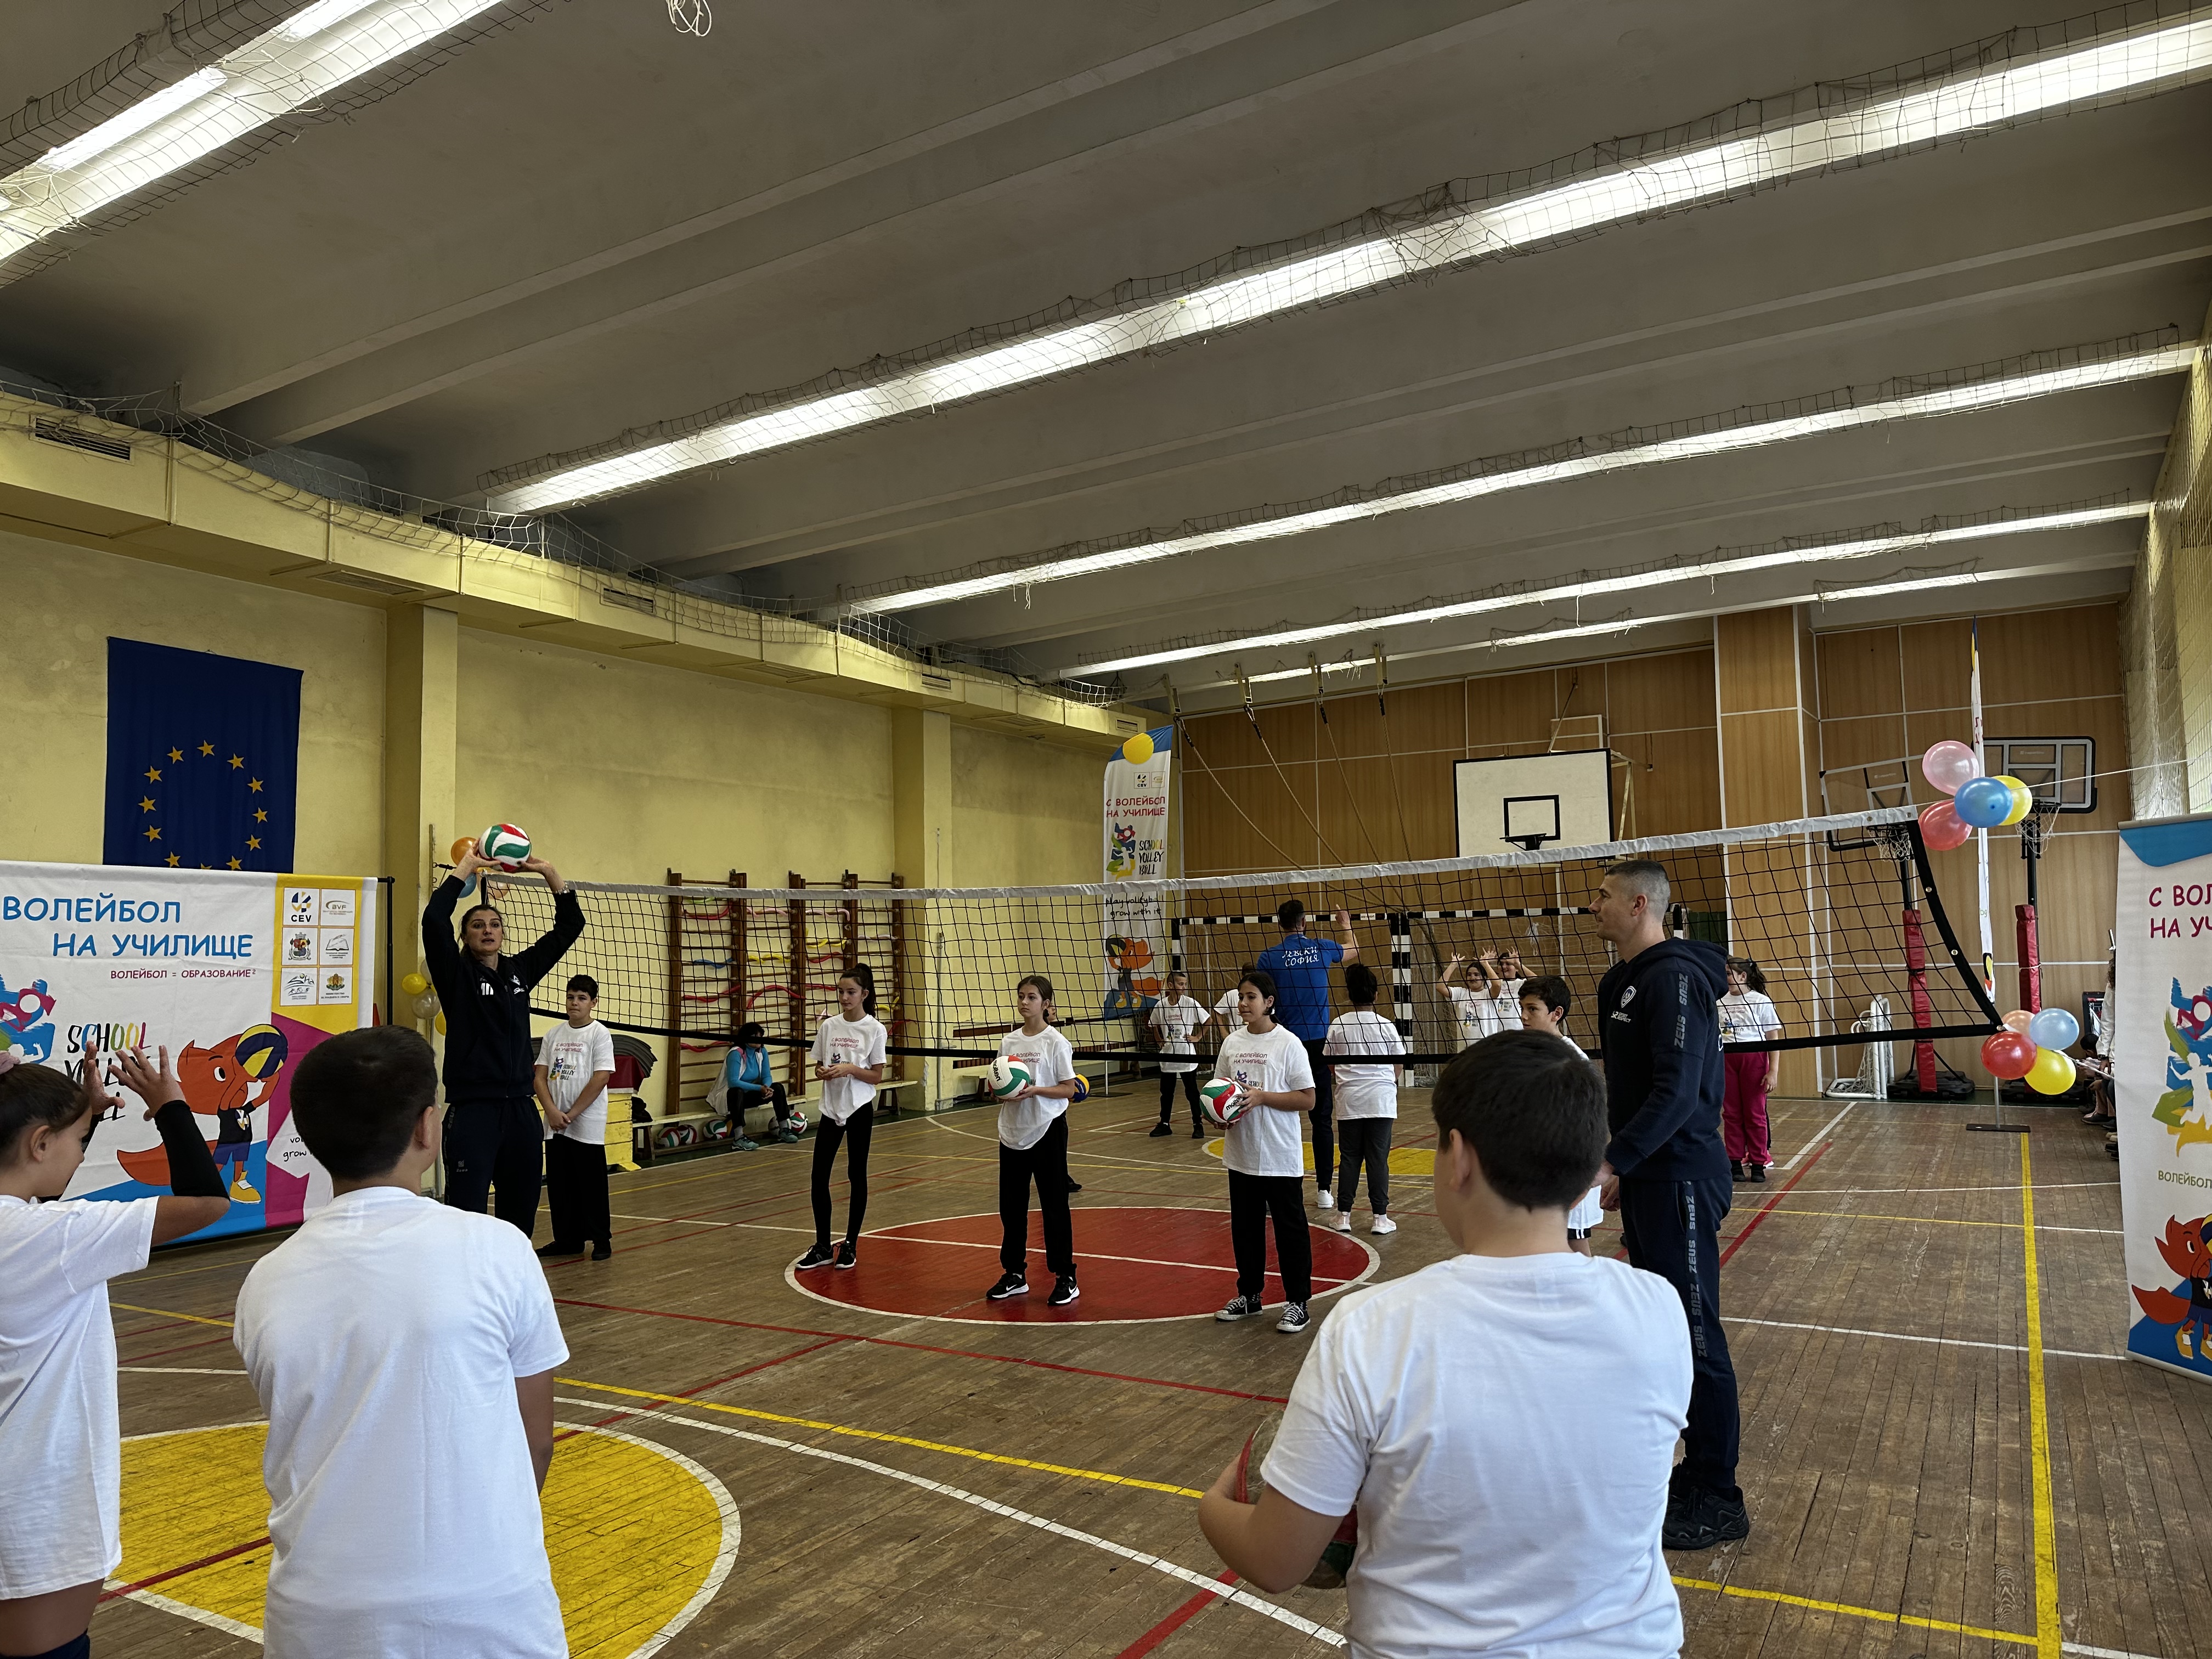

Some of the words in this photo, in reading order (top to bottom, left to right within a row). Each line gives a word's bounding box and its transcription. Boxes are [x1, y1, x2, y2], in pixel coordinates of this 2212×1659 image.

[1115, 795, 1165, 806] ВОЛЕЙБОЛ
[1106, 809, 1119, 817] НА
[1122, 807, 1165, 817] УЧИЛИЩЕ
[1139, 839, 1164, 851] SCHOOL
[1138, 851, 1164, 864] VOLLEY
[1139, 864, 1157, 876] BALL
[2149, 887, 2162, 907] С
[3, 892, 180, 923] ВОЛЕЙБОЛ
[1110, 910, 1130, 919] grow
[1133, 906, 1151, 916] with
[2151, 917, 2181, 939] НА
[53, 933, 97, 957] НА
[112, 934, 253, 960] УЧИЛИЩЕ
[1282, 946, 1318, 958] ЛЕВСКИ
[1285, 954, 1320, 967] СОФИЯ
[110, 968, 167, 979] ВОЛЕЙБОЛ
[1679, 973, 1689, 1006] ZEUS
[67, 1022, 152, 1053] SCHOOL
[1674, 1014, 1686, 1048] ZEUS
[283, 1150, 307, 1162] grow
[2158, 1170, 2212, 1189] ВОЛЕЙБОЛ
[1685, 1195, 1696, 1230] ZEUS
[1688, 1239, 1697, 1274] ZEUS
[1690, 1283, 1701, 1317] ZEUS
[1693, 1325, 1707, 1358] ZEUS
